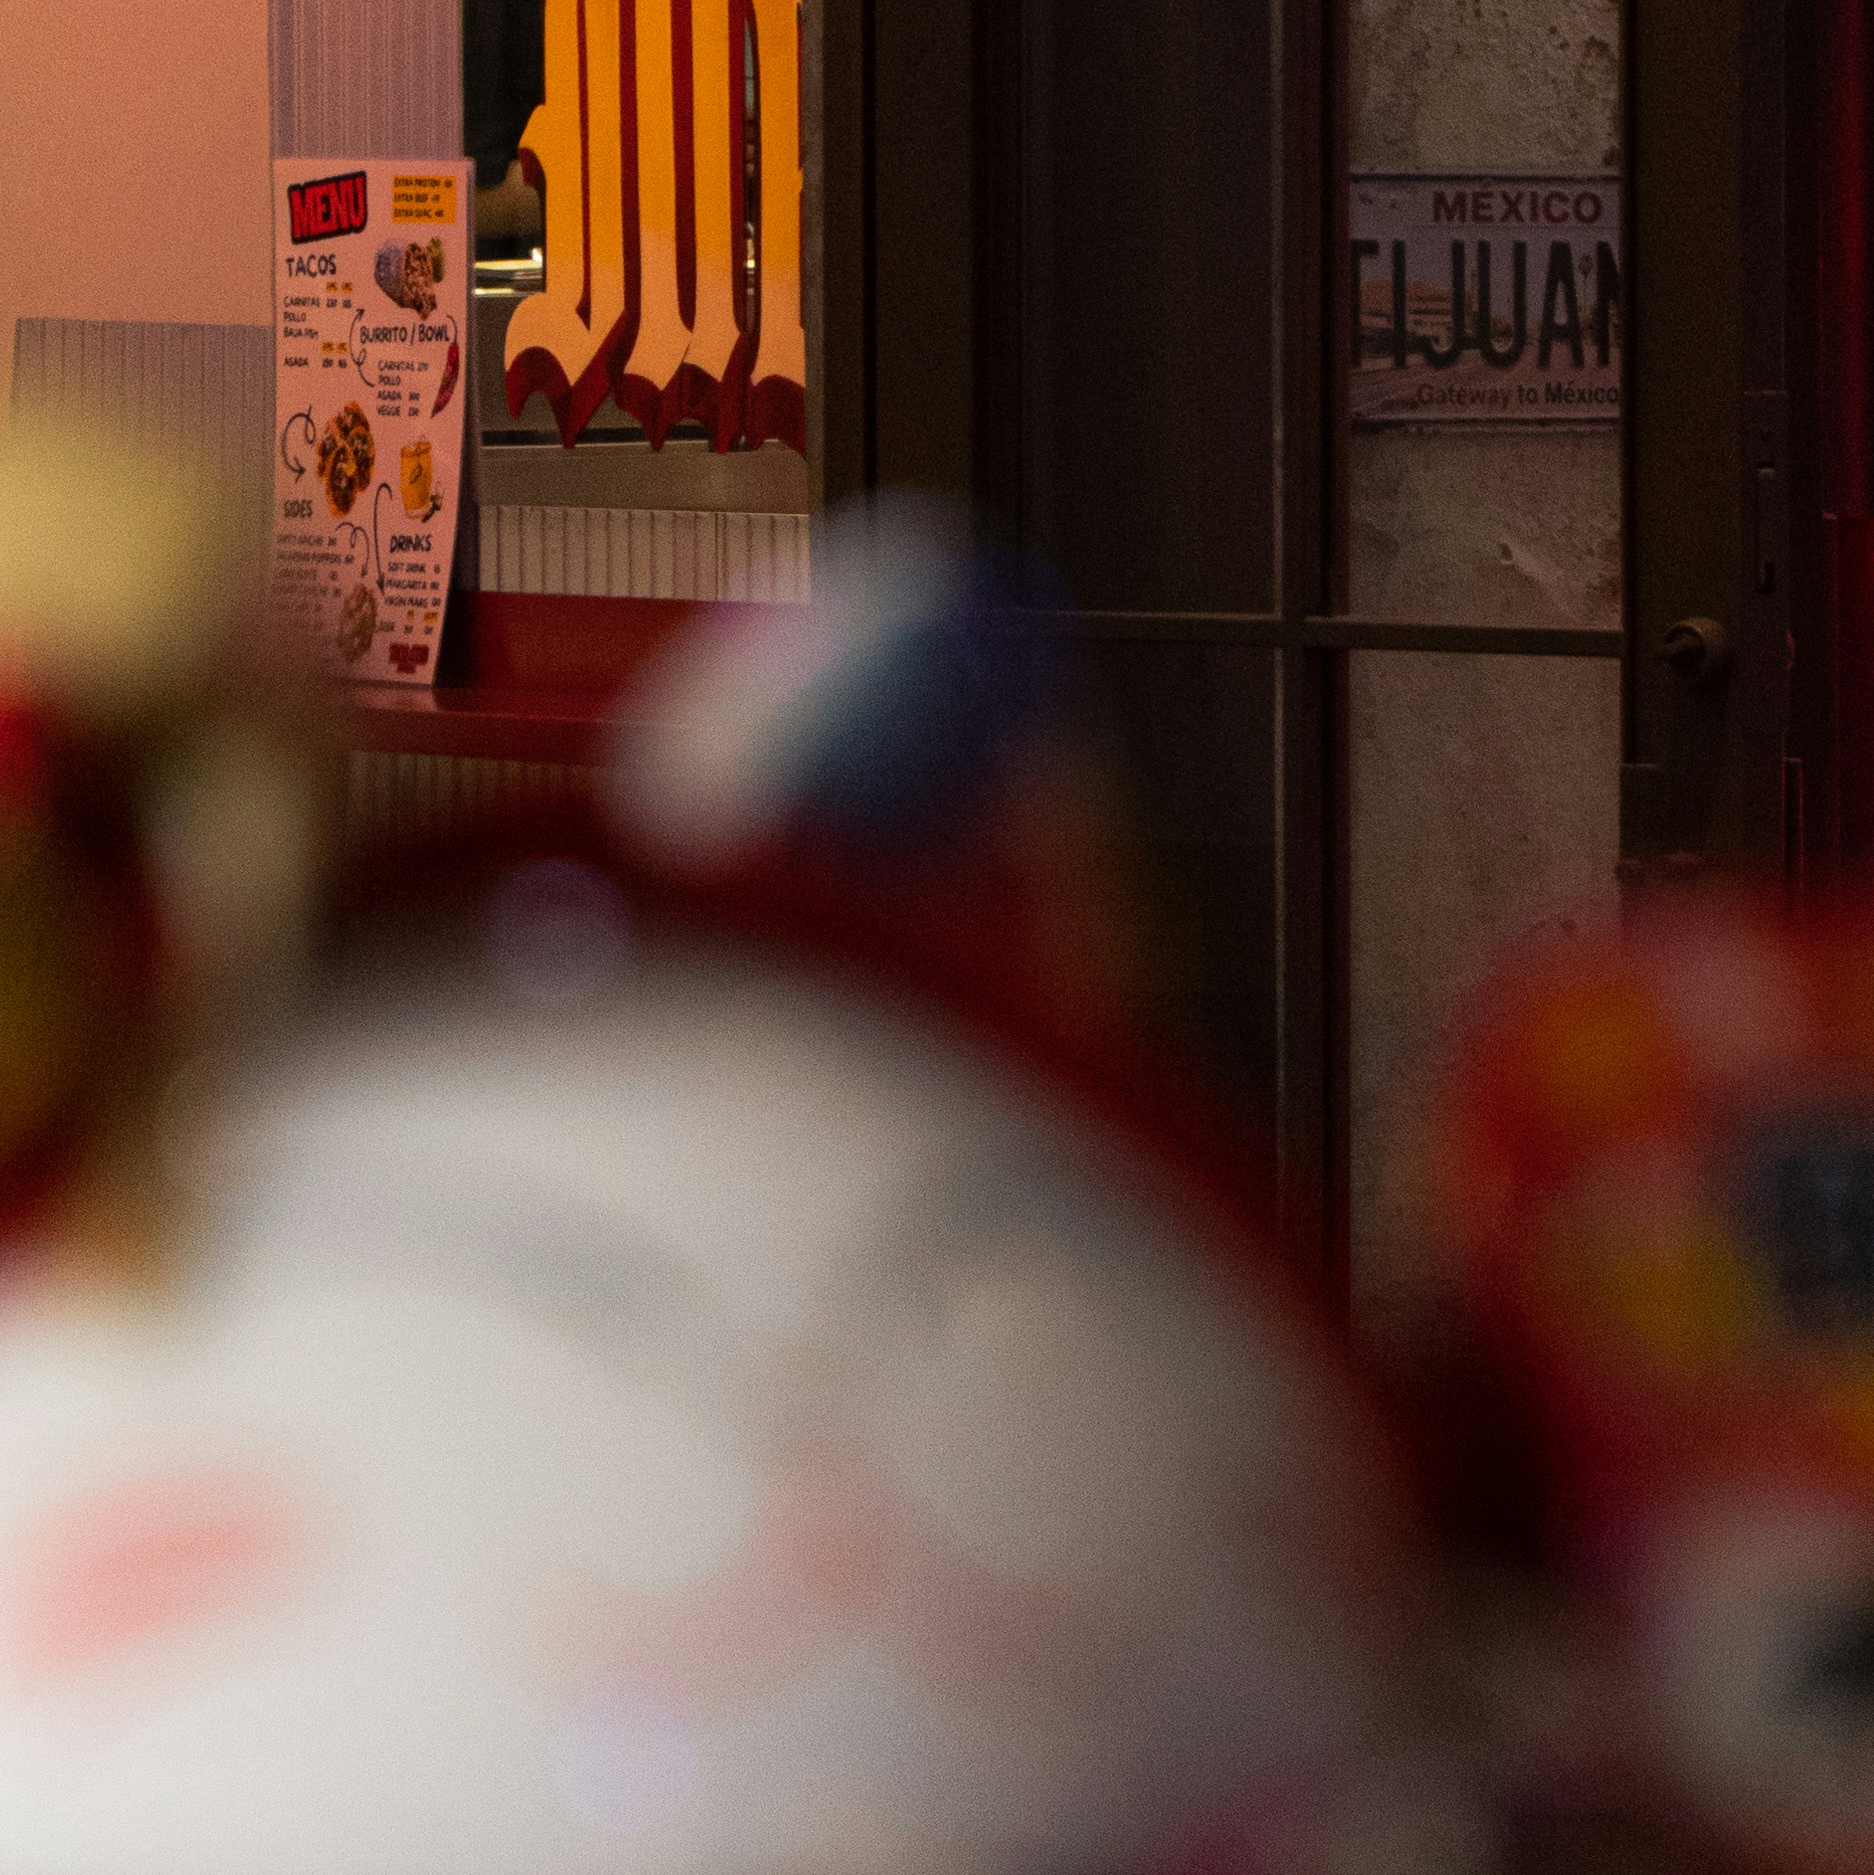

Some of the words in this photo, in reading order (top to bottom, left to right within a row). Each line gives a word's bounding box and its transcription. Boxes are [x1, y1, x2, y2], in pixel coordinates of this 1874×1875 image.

[290, 172, 368, 243] MENU
[285, 254, 337, 278] TACOS
[360, 325, 407, 345] BURRITO
[419, 323, 450, 342] BOWL
[1517, 384, 1538, 404] to
[283, 499, 314, 518] SIDES
[389, 534, 432, 553] DRINKS
